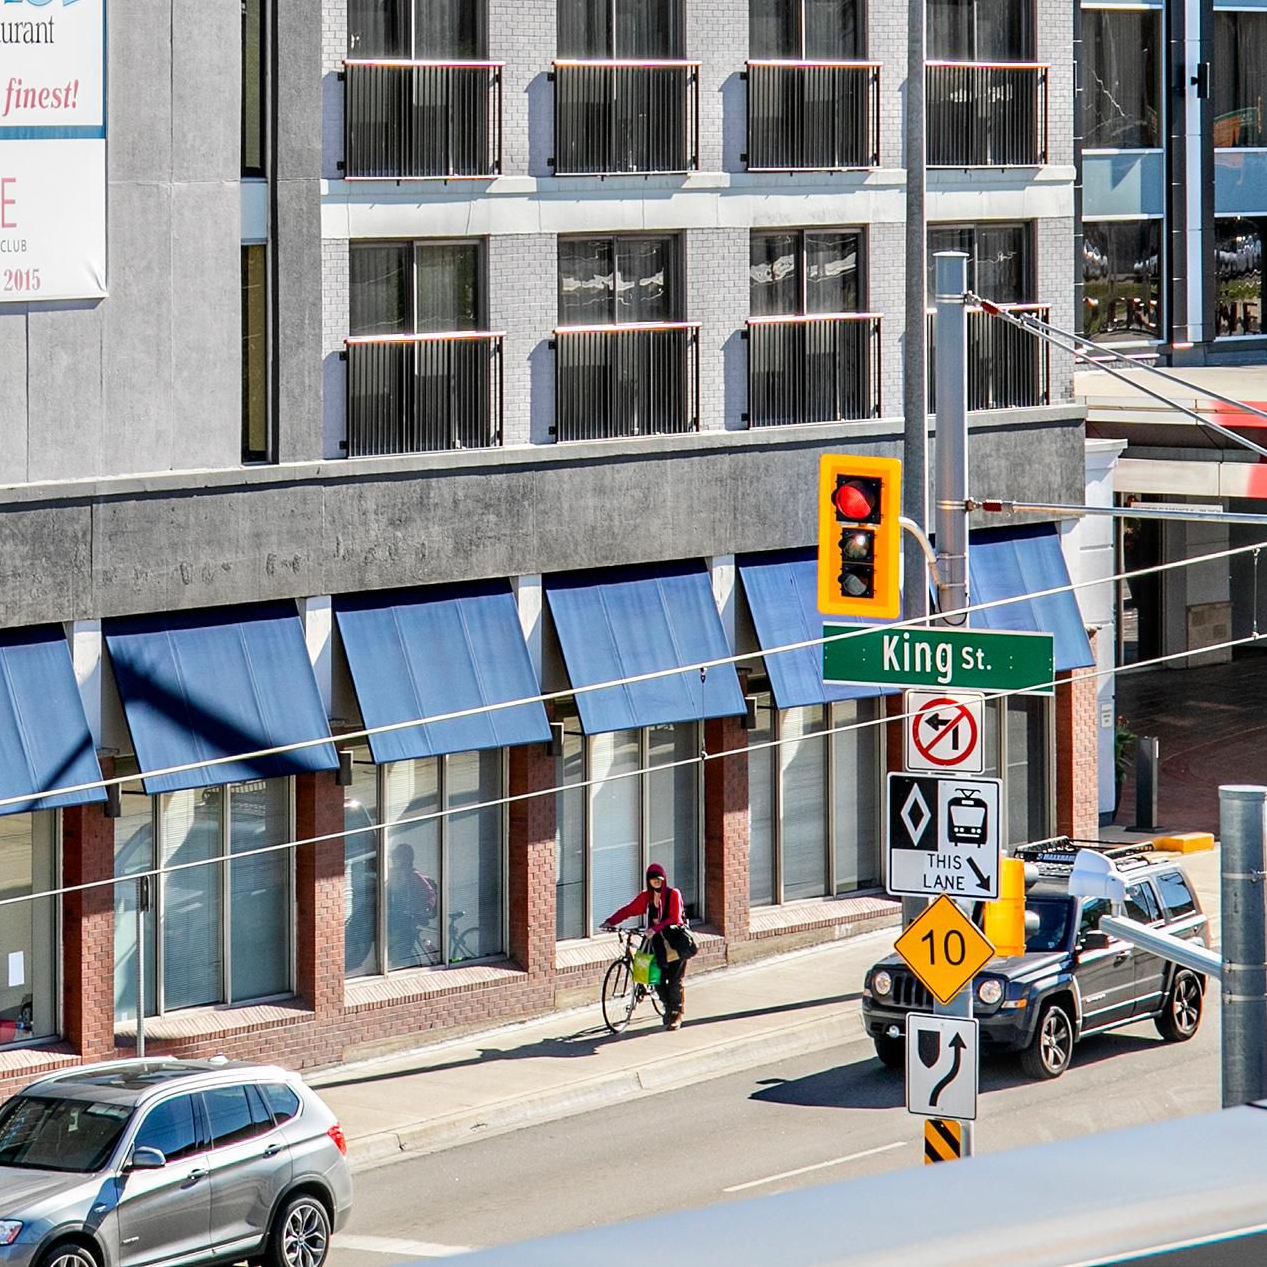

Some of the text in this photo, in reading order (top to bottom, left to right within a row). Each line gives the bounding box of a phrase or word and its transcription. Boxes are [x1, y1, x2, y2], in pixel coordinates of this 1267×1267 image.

[2, 78, 80, 117] finest!
[0, 239, 28, 253] CLUB
[3, 267, 41, 292] 2015
[883, 632, 993, 684] King St.
[927, 853, 963, 870] THIS
[922, 873, 966, 891] LANE
[920, 928, 966, 967] 10
